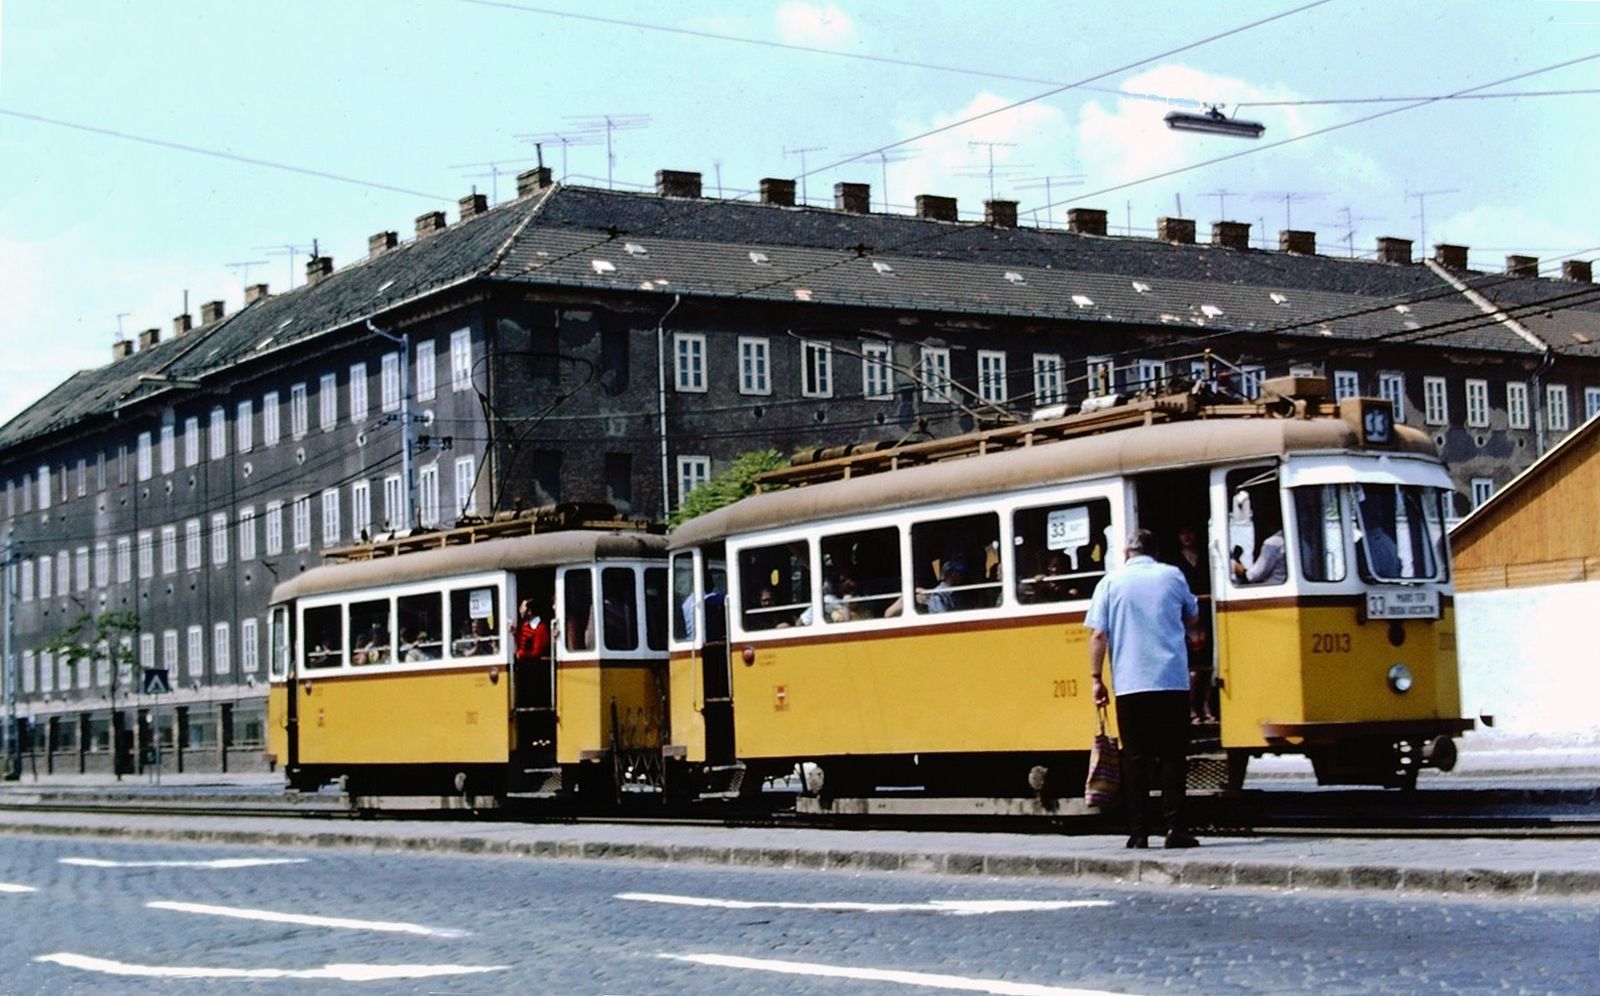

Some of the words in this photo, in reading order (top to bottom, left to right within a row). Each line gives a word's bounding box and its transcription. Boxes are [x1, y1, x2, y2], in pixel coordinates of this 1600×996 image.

[1051, 522, 1066, 538] 33
[1370, 596, 1386, 615] 33
[1312, 632, 1352, 654] 2013
[1053, 679, 1078, 698] 2013
